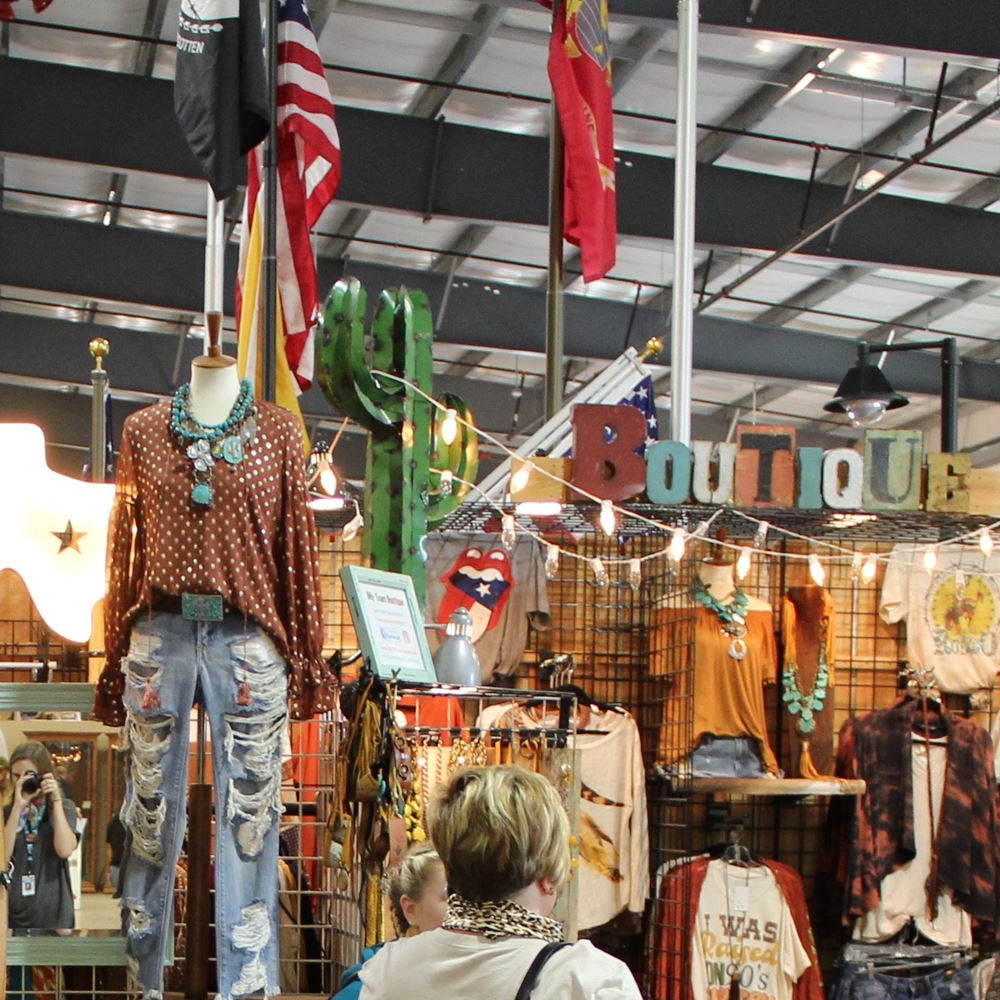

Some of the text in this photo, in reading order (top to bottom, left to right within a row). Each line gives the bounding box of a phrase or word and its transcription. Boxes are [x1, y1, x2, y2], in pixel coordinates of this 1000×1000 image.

[570, 404, 971, 511] BOUTIQUE
[704, 913, 778, 944] I WAS
[701, 930, 780, 966] Raised
